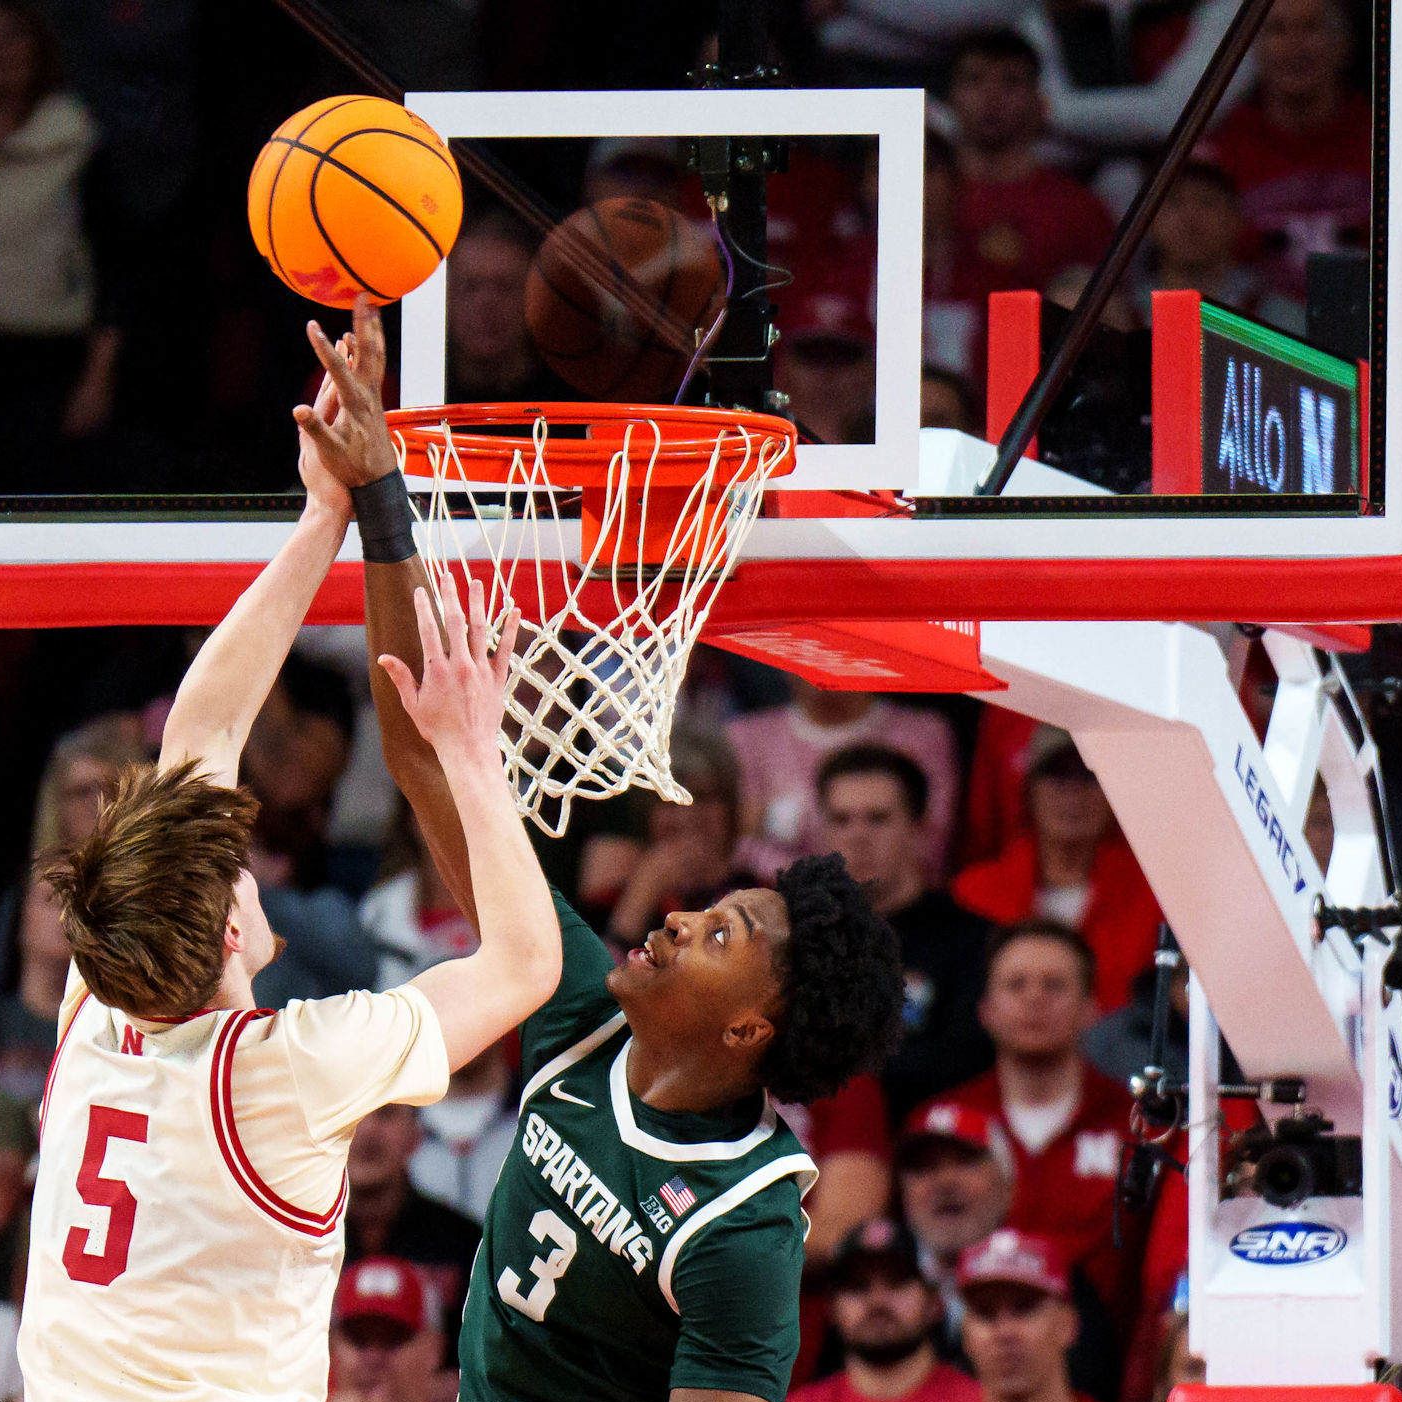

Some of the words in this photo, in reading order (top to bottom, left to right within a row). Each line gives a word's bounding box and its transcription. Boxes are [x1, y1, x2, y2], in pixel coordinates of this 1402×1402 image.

[121, 1024, 145, 1056] N
[61, 1104, 148, 1287] 5
[521, 1112, 654, 1277] SPARTANS
[497, 1208, 578, 1323] 3
